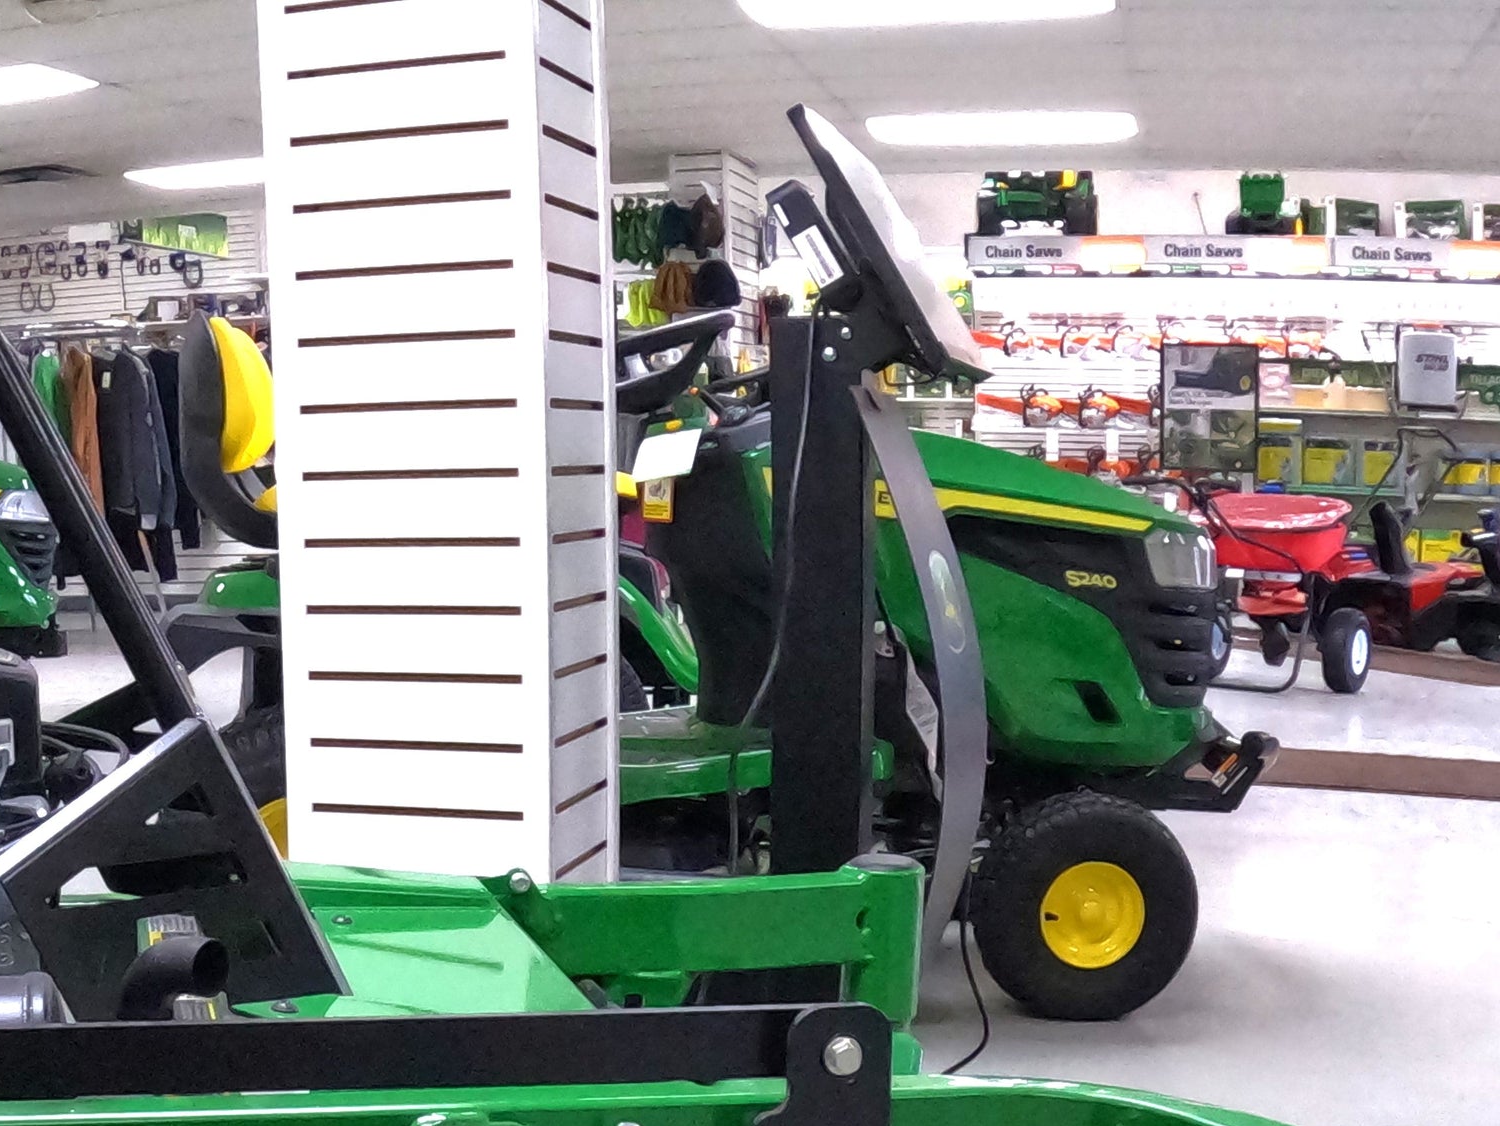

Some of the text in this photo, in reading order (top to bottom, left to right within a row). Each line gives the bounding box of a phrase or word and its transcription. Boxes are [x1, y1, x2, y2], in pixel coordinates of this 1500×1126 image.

[985, 245, 1063, 258] Chain Saws
[1164, 244, 1243, 259] Chain Saws
[1352, 246, 1432, 262] Chain Saws
[1065, 570, 1118, 588] S240
